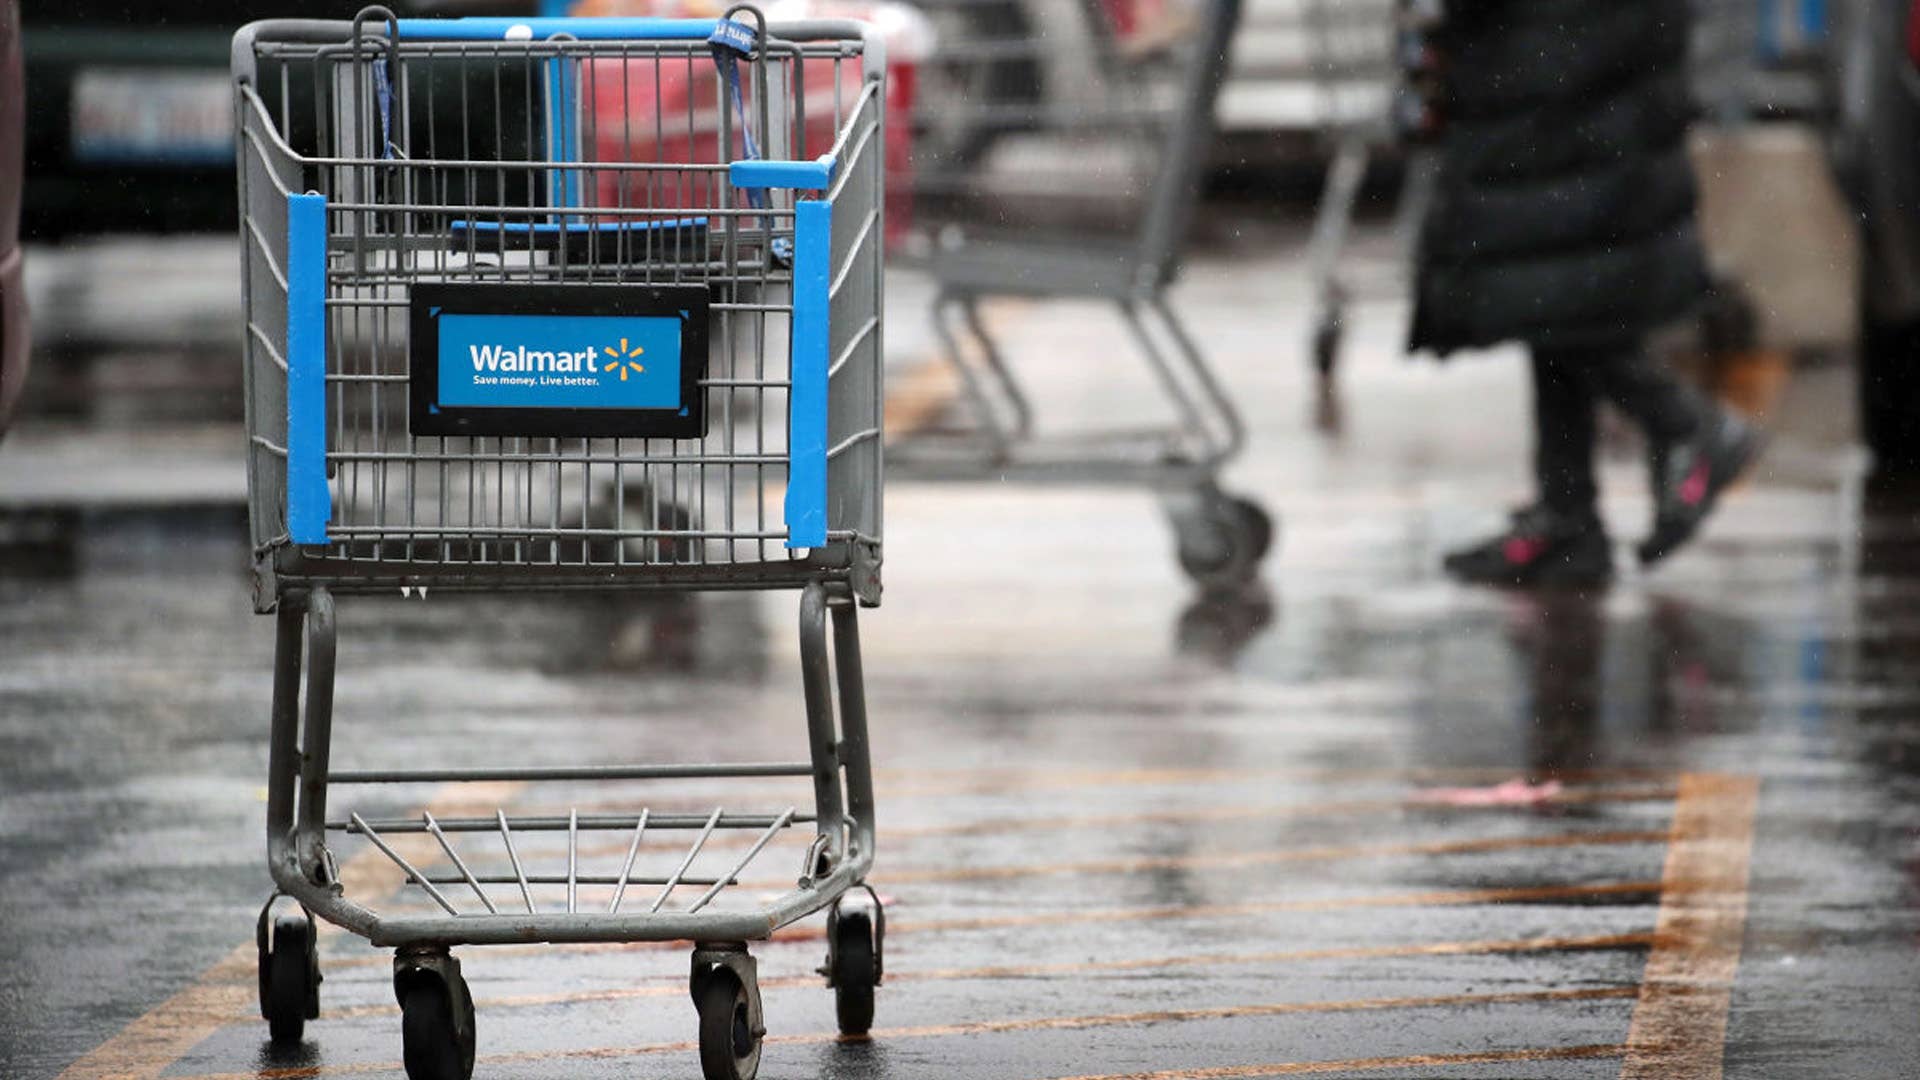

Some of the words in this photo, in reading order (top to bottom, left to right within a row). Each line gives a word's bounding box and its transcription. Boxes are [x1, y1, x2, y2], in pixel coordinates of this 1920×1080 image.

[470, 345, 598, 372] Walmart
[473, 375, 497, 385] Save
[500, 376, 537, 387] money.
[540, 376, 562, 385] Live
[564, 376, 599, 386] better.
